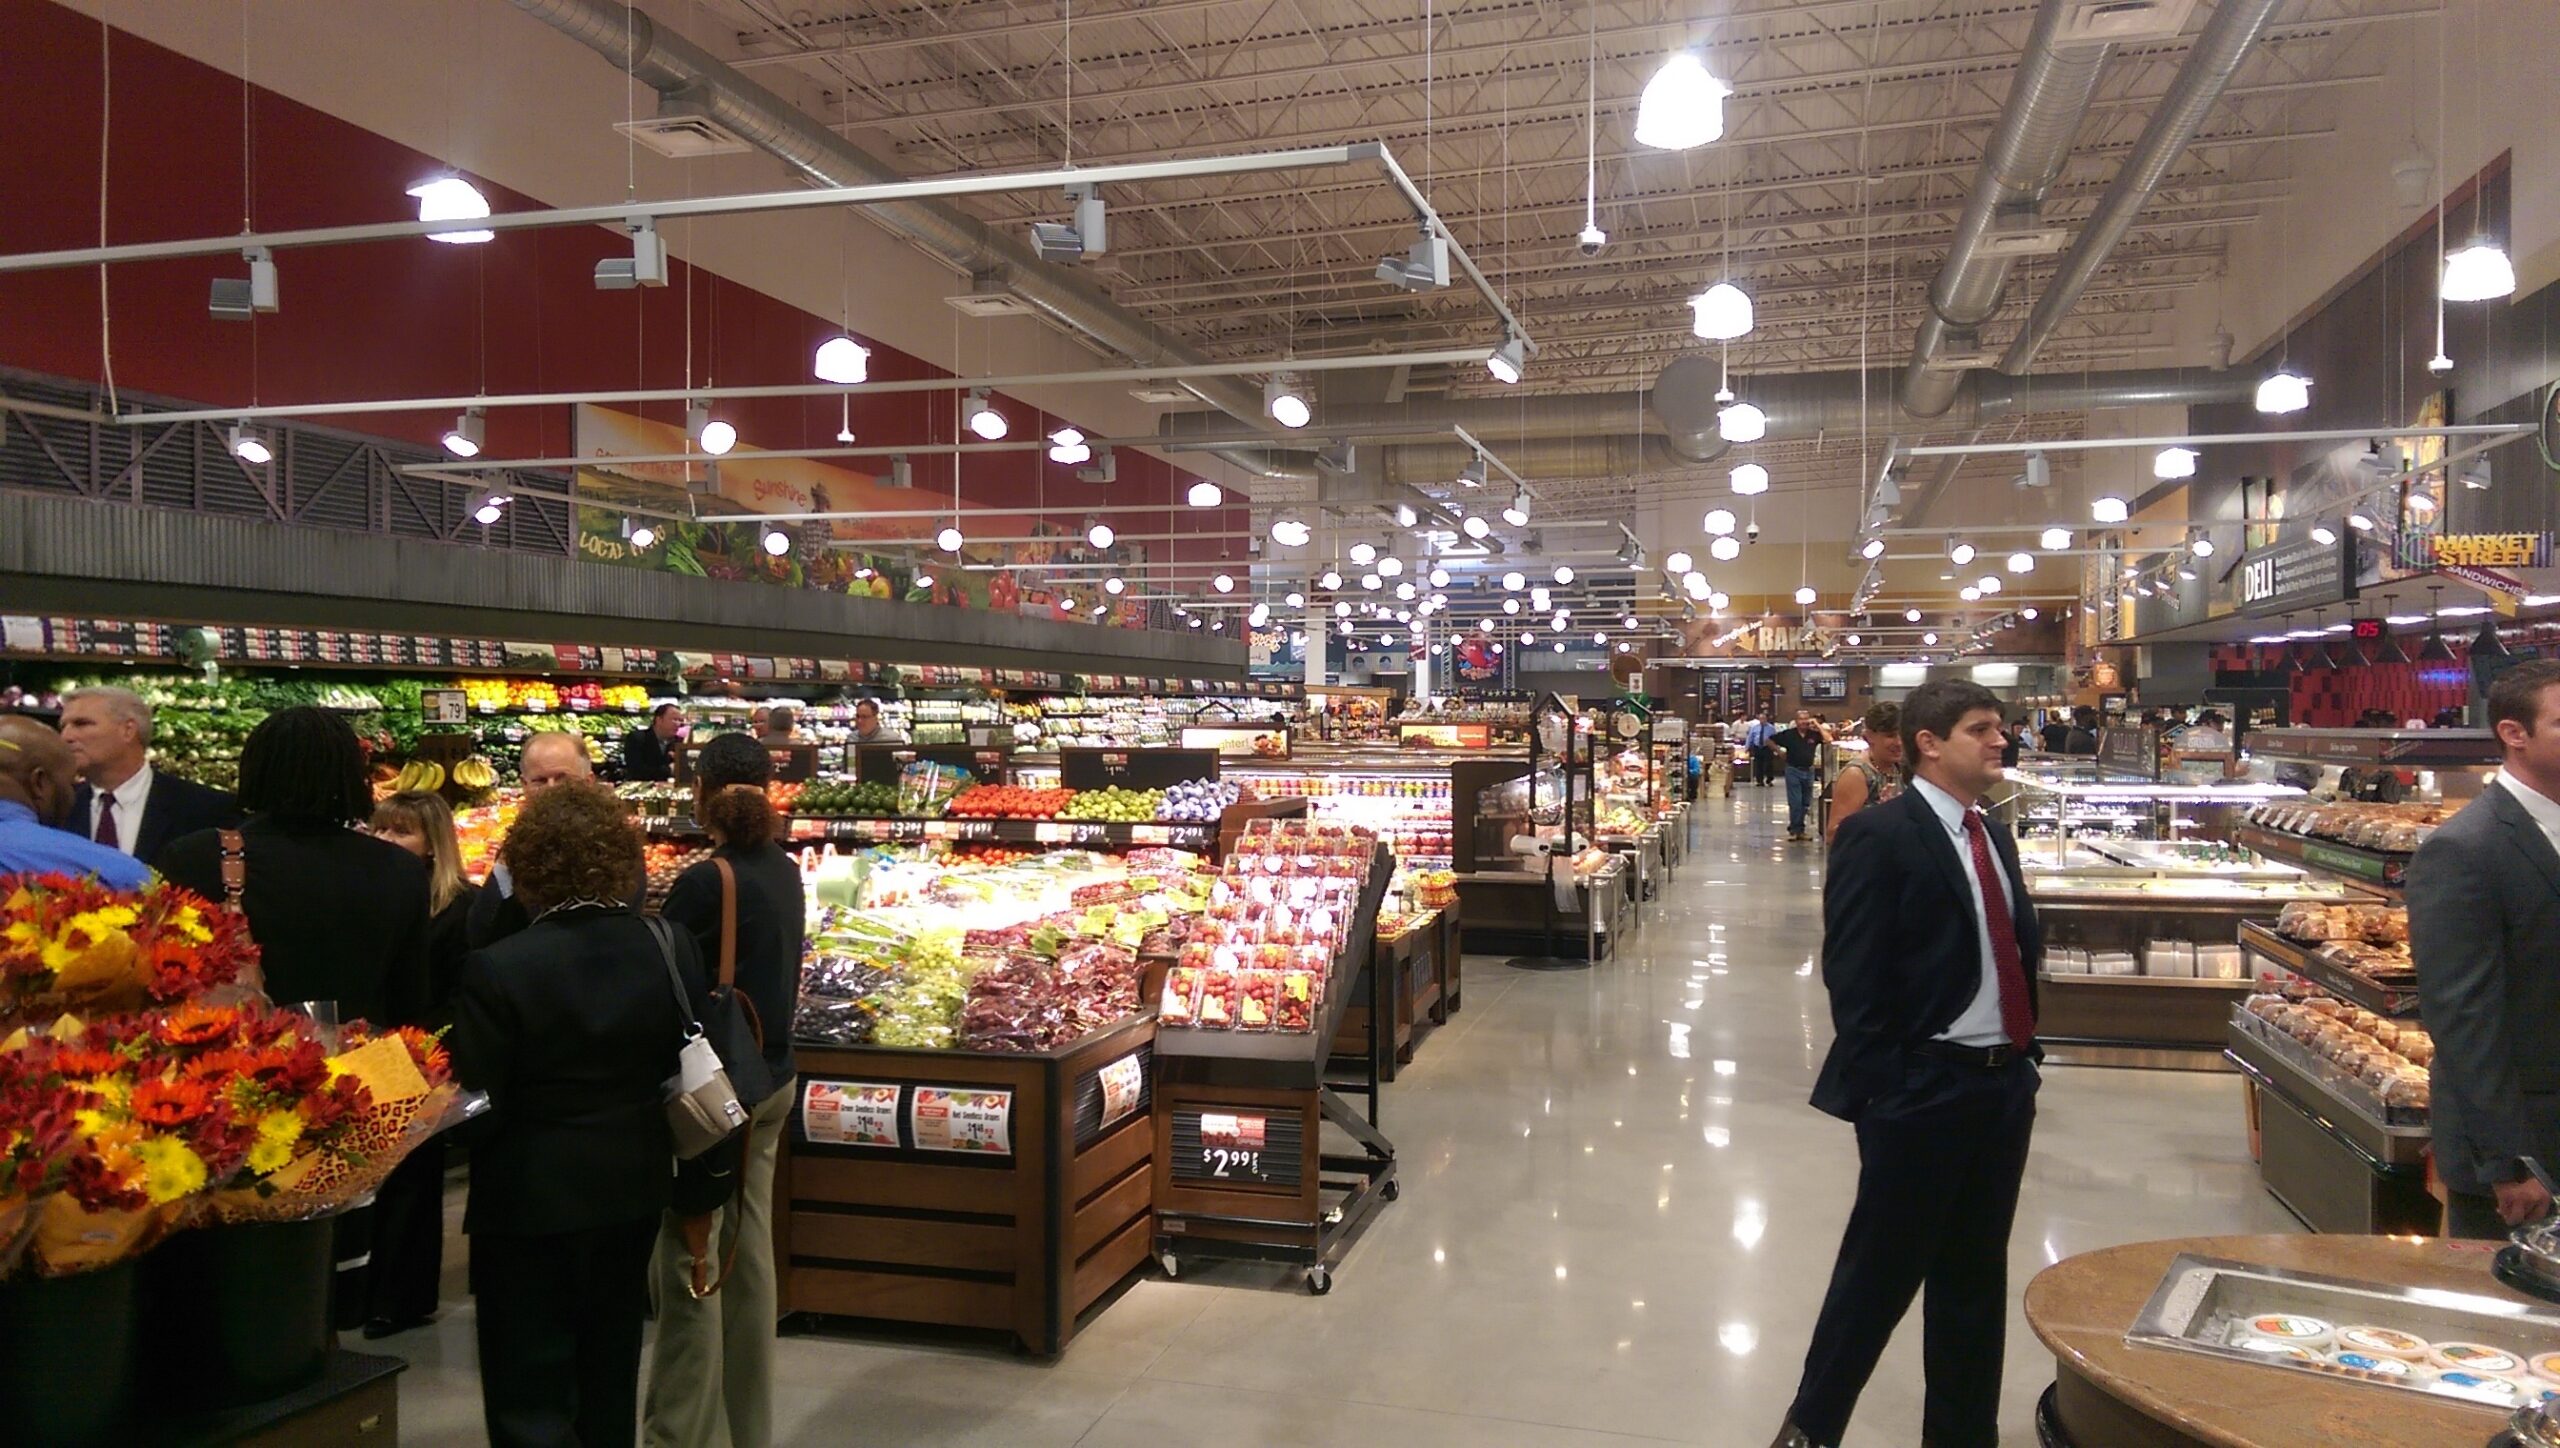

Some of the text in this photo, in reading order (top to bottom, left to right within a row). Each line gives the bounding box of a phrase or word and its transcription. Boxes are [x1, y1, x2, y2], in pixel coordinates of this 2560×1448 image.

[753, 478, 808, 507] Sunshine
[579, 531, 624, 560] LOCAL
[2434, 534, 2539, 551] MARKET
[2438, 550, 2533, 566] STREET
[2244, 558, 2274, 602] DELI
[2445, 565, 2531, 598] SANDWICHES
